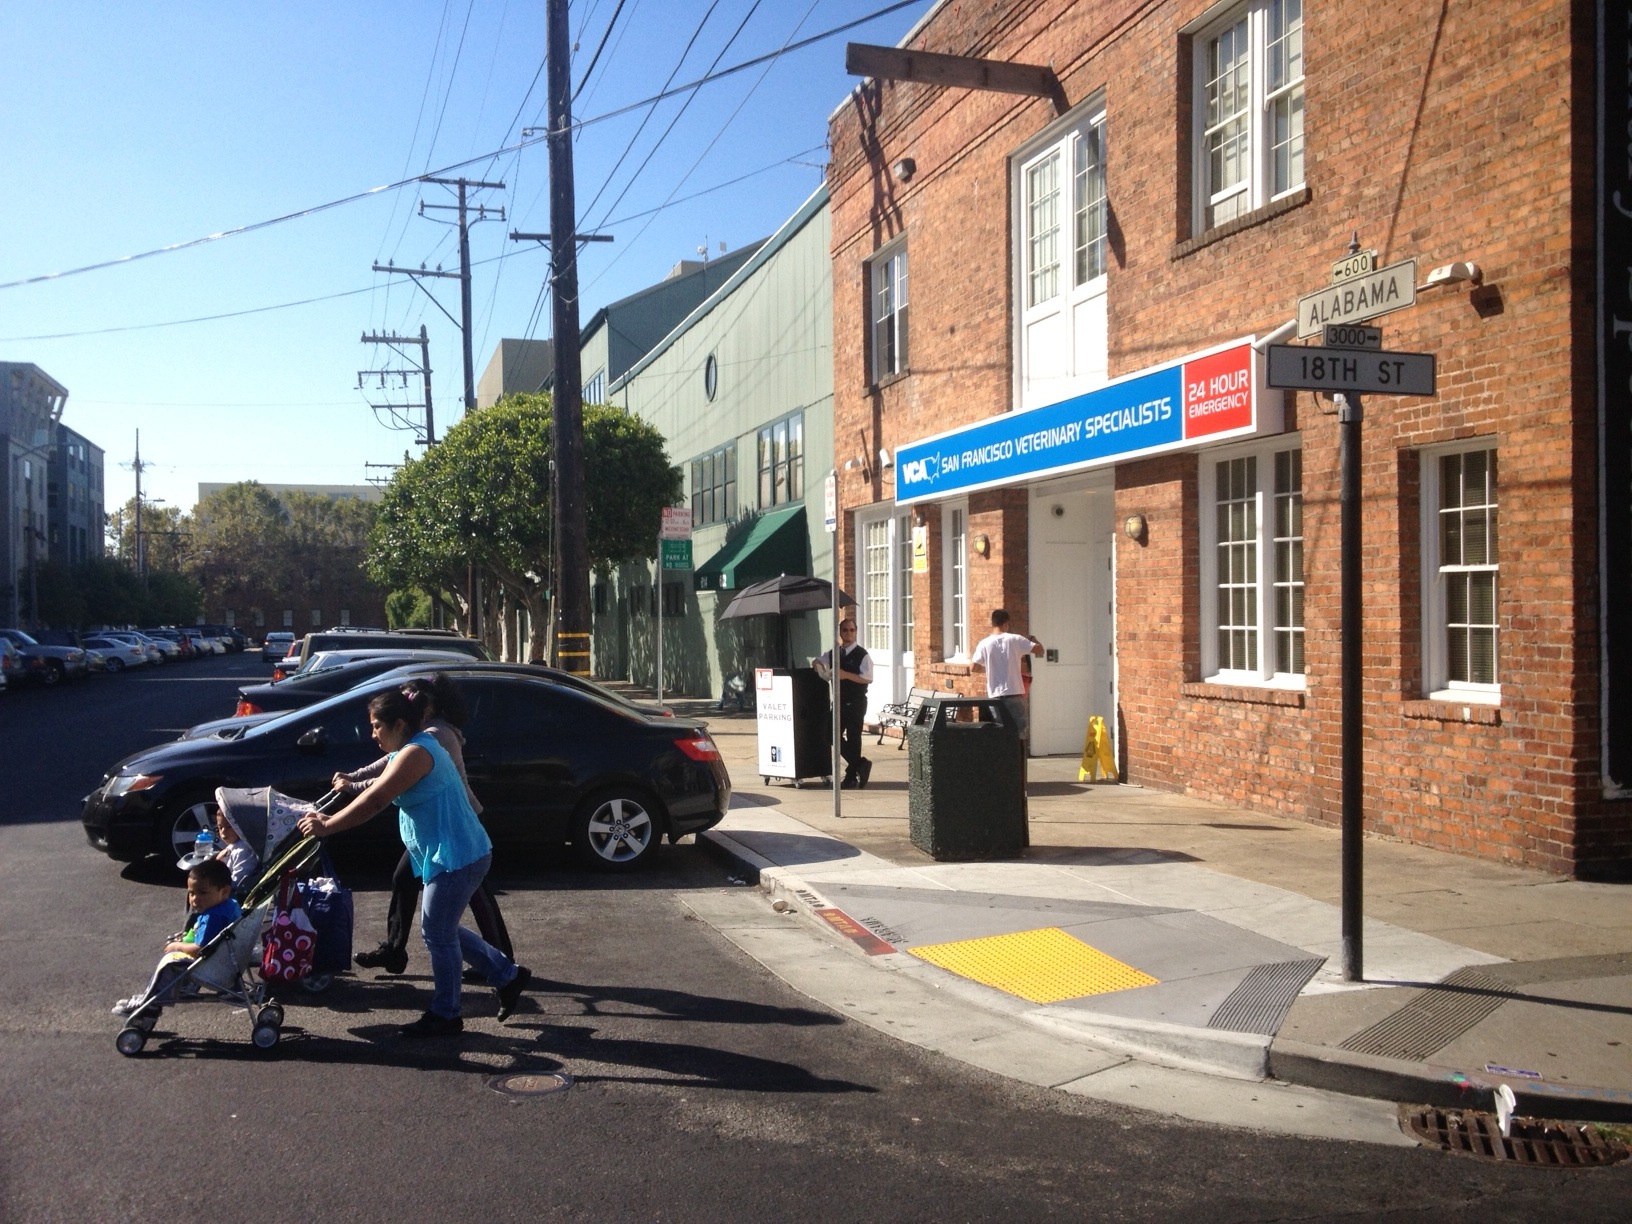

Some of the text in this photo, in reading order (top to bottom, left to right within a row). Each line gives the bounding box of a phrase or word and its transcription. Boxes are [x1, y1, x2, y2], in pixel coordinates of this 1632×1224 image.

[1344, 255, 1368, 277] 600
[1309, 276, 1399, 327] ALABAMA
[1329, 328, 1366, 345] 3000
[1301, 356, 1405, 384] 18TH ST
[1188, 368, 1248, 401] 24 HOUR
[1188, 391, 1248, 418] EMERGENCY
[902, 397, 1172, 484] VCA SAN FRANCISCO VETERINARY SPECIALISTS
[758, 713, 792, 722] PARKING
[762, 703, 787, 711] VALET
